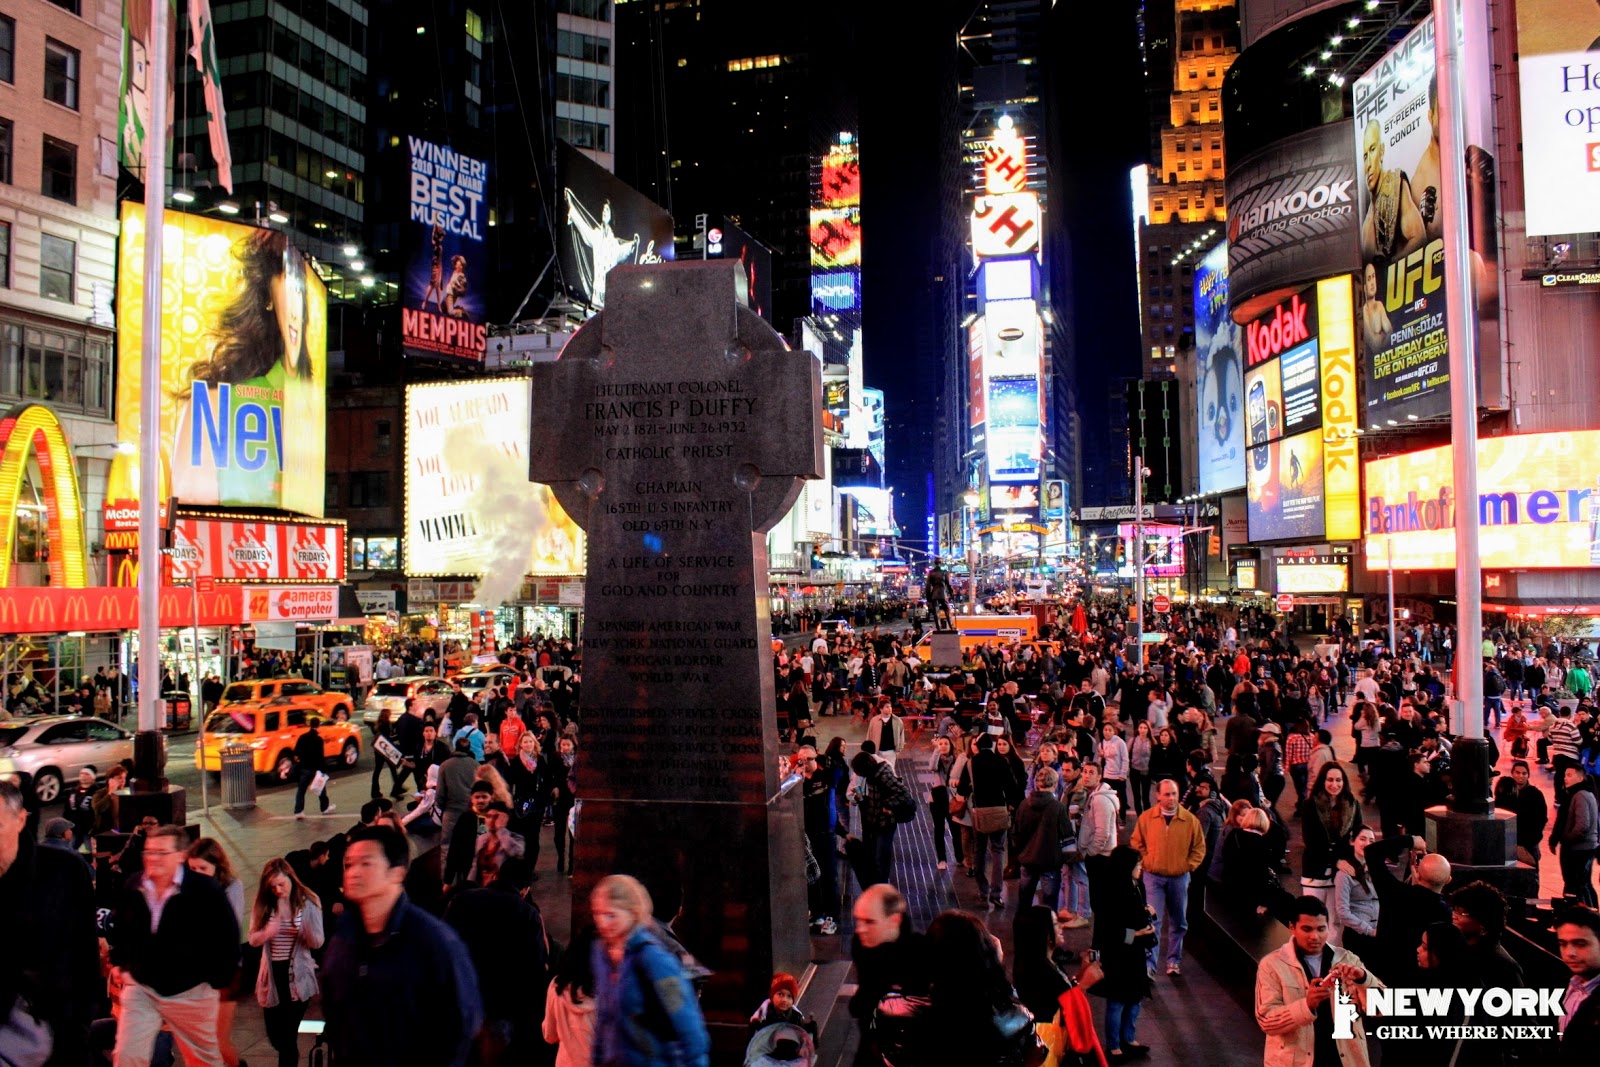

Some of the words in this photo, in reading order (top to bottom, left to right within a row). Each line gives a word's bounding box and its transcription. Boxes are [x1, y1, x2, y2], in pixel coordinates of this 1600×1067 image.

[1384, 94, 1426, 134] ST-PIERRE
[1390, 117, 1421, 147] CONDIT
[408, 135, 486, 181] WINNER!
[411, 157, 433, 175] 2010
[435, 164, 455, 184] TONY
[457, 173, 483, 193] AWARD
[411, 171, 483, 222] BEST
[410, 202, 483, 241] MUSICAL
[1251, 221, 1287, 240] driving
[1289, 205, 1352, 226] emotion
[1386, 238, 1444, 313] UFC
[402, 307, 486, 351] MEMPHIS
[1247, 294, 1309, 366] Kodak
[1391, 326, 1414, 345] PENN
[1420, 312, 1443, 332] DIAZ
[1374, 337, 1422, 366] SATURDAY
[1374, 363, 1391, 379] LIVE
[1392, 358, 1405, 373] ON
[236, 384, 270, 399] SIMPLY
[595, 382, 674, 397] LIEUTENANT
[678, 380, 743, 395] COLONEL
[585, 401, 663, 420] FRANCIS
[689, 398, 757, 417] DUFFY
[1324, 347, 1355, 473] Kodak
[594, 425, 620, 437] MAY
[606, 447, 674, 460] CATHOLIC
[683, 445, 733, 458] PRIEST
[635, 481, 702, 495] CHAPLAIN
[674, 501, 734, 513] INFANTRY
[1369, 490, 1422, 535] Bank
[1424, 486, 1453, 531] of
[622, 521, 650, 532] OLD
[607, 558, 617, 569] A
[623, 557, 649, 569] LIFE
[655, 557, 673, 568] OF
[679, 556, 735, 568] SERVICE
[1277, 556, 1348, 564] MARQUIS
[657, 572, 680, 581] FOR
[602, 585, 634, 597] GOD
[638, 585, 667, 597] AND
[672, 585, 740, 597] COUNTRY
[249, 597, 268, 614] 47
[599, 622, 645, 632] SPANISH
[649, 622, 711, 632] AMERICAN
[715, 622, 742, 632] WAR
[584, 639, 611, 649] NEW
[614, 639, 645, 649] YORK
[650, 639, 710, 650] NATIONAL
[714, 638, 757, 649] GUARD
[616, 656, 671, 666] MEXICAN
[675, 656, 724, 667] BORDER
[629, 672, 674, 684] WORLD
